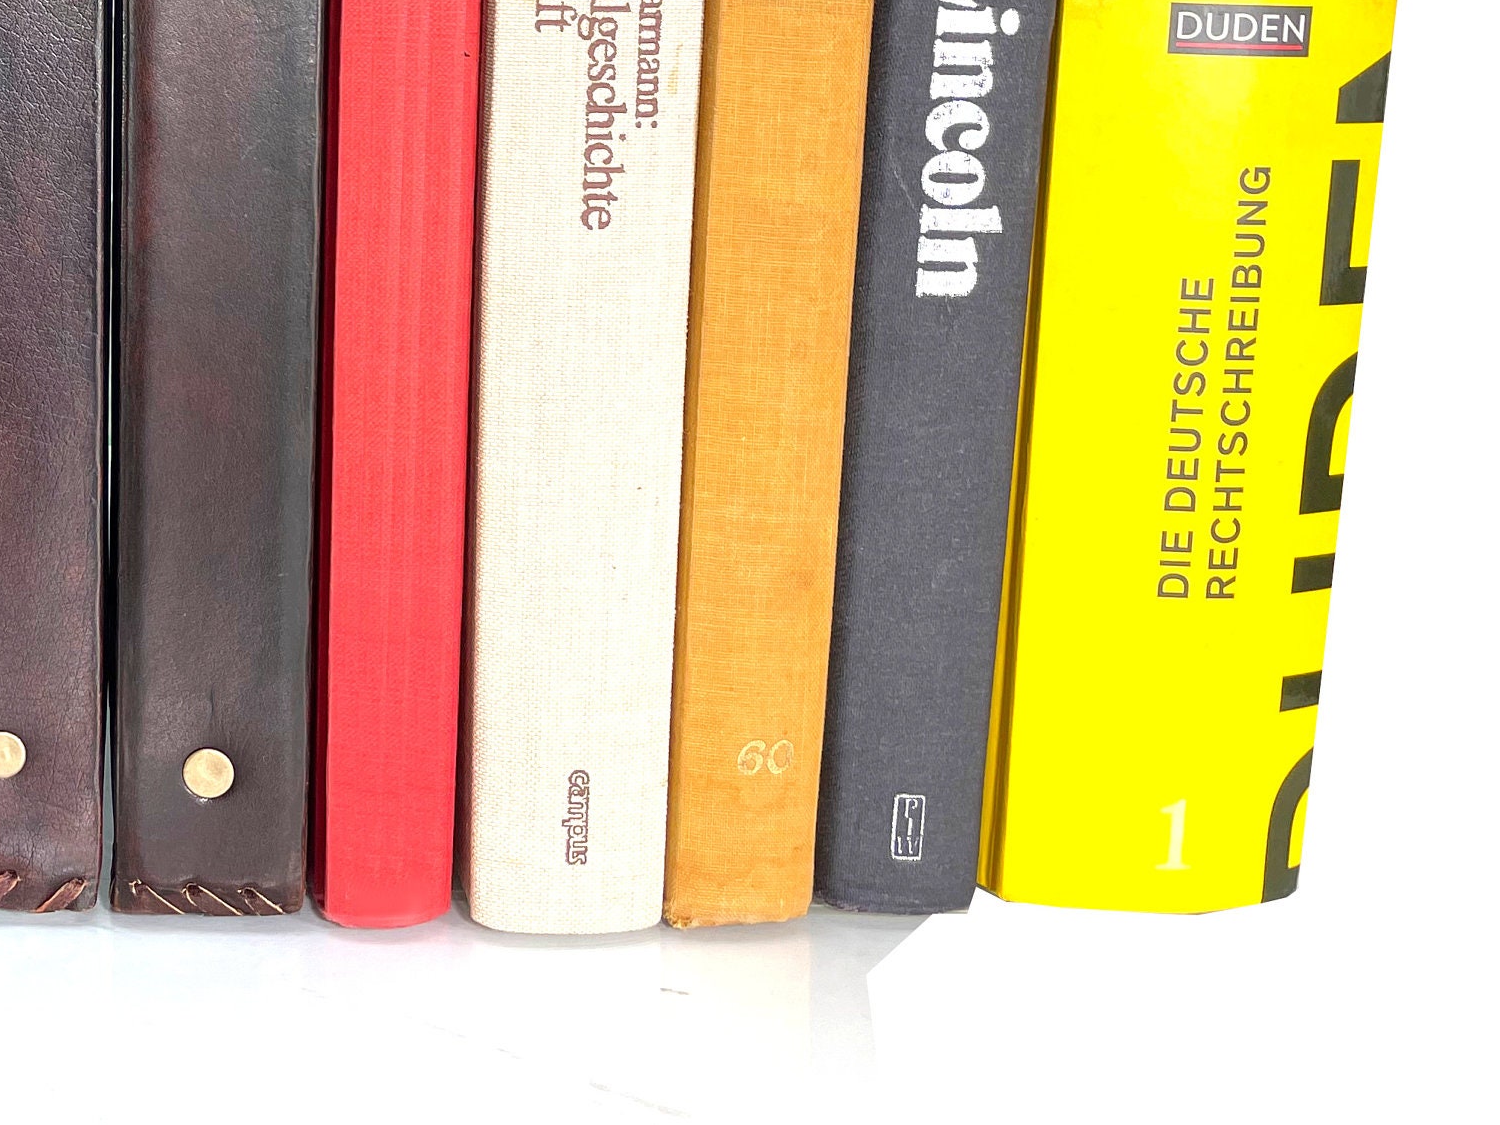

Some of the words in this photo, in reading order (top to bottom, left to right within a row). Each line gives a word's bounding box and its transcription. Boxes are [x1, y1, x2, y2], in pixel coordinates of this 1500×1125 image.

[1175, 10, 1307, 44] DUDEN
[1164, 277, 1214, 513] DEUTSCHE
[1206, 166, 1272, 600] RECHTSCHREIBUNG
[1157, 530, 1195, 600] DIE
[737, 739, 794, 776] 60
[561, 769, 590, 865] campus
[1155, 797, 1192, 871] 1
